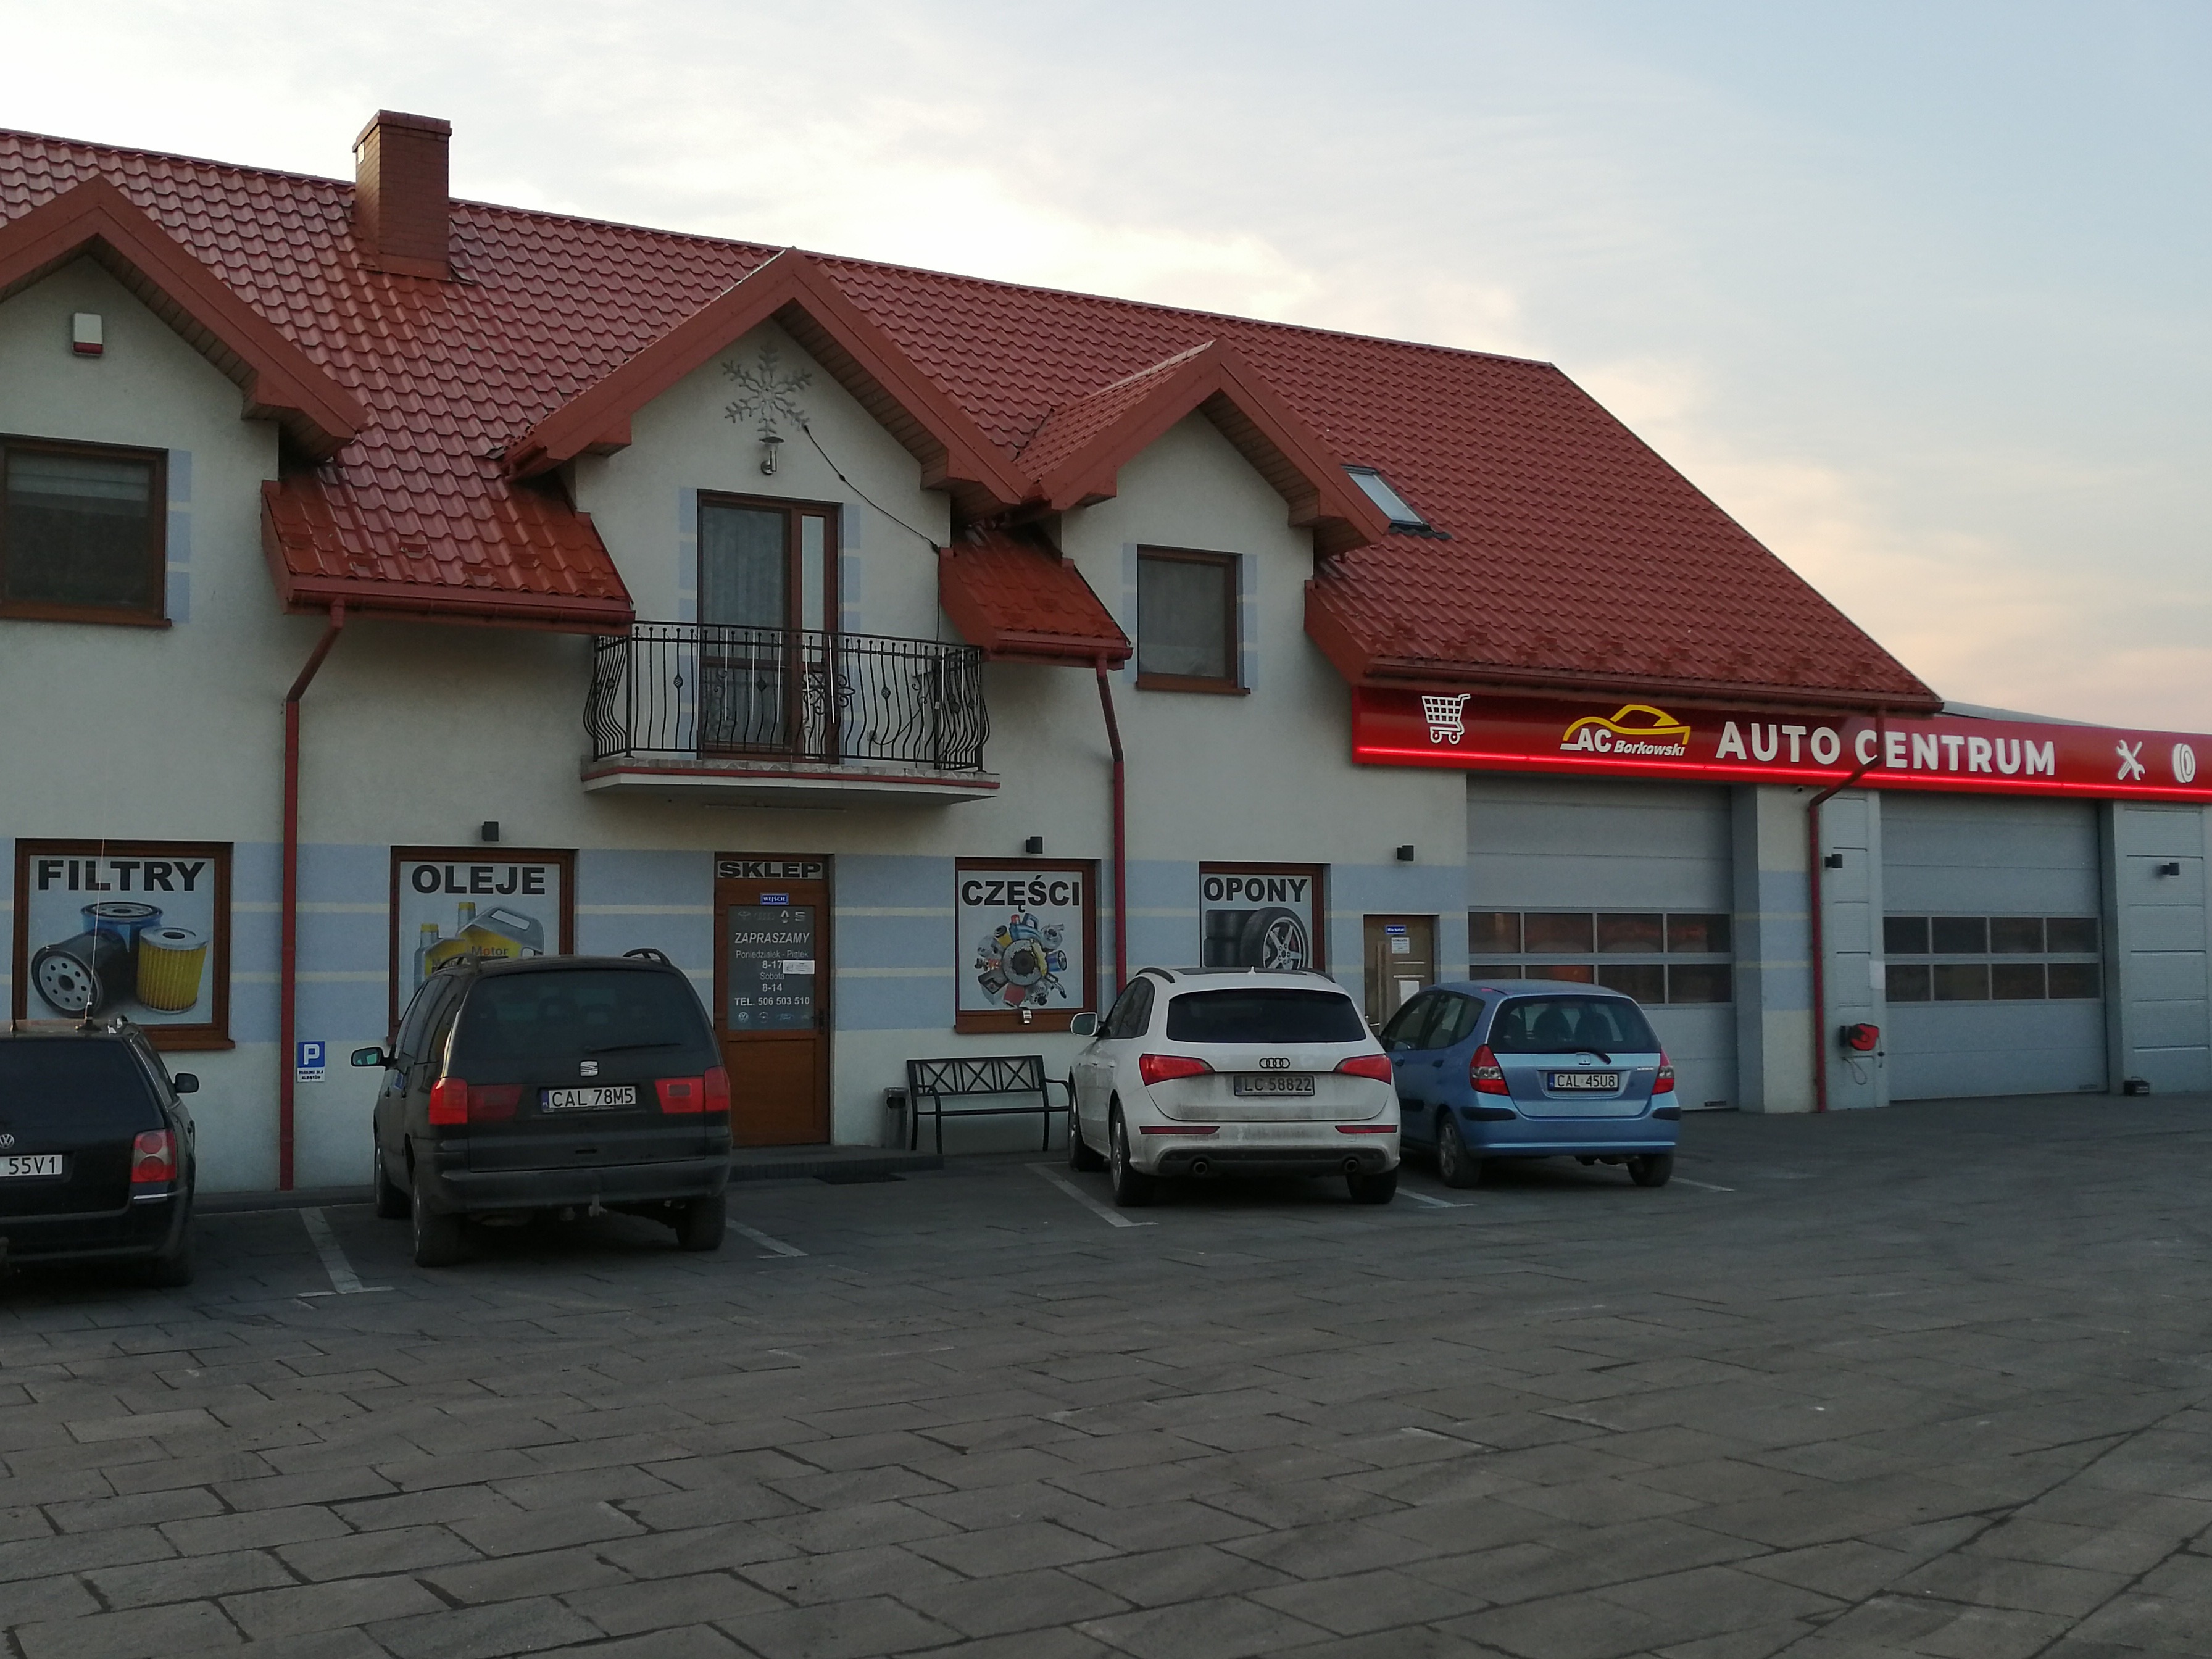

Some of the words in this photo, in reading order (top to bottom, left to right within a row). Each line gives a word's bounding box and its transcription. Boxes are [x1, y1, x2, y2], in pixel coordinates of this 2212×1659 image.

[1613, 740, 1686, 756] Borkowski
[1715, 721, 1841, 765] AUTO
[1855, 730, 2055, 776] CENTRUM
[38, 860, 205, 892] FILTRY
[720, 862, 821, 878] SKLEP
[412, 865, 546, 894] OLEJE
[962, 875, 1079, 913] CZĘŚCI
[1204, 877, 1308, 904] OPONY
[734, 932, 810, 944] ZAPRASZAMY
[472, 946, 509, 956] Motor
[762, 960, 783, 969] 8-17
[760, 971, 784, 980] Sobota
[762, 983, 783, 992] 8-14
[734, 997, 755, 1006] TEL.
[758, 997, 773, 1005] 506
[776, 997, 792, 1005] 503
[794, 997, 810, 1005] 510
[304, 1044, 320, 1065] P
[1245, 1078, 1263, 1091] LC
[1269, 1078, 1312, 1091] 58822
[1557, 1075, 1580, 1087] CAL
[1586, 1075, 1615, 1087] 45U8
[552, 1091, 587, 1107] CAL
[594, 1088, 633, 1105] 78M5
[9, 1157, 55, 1175] 55V1
